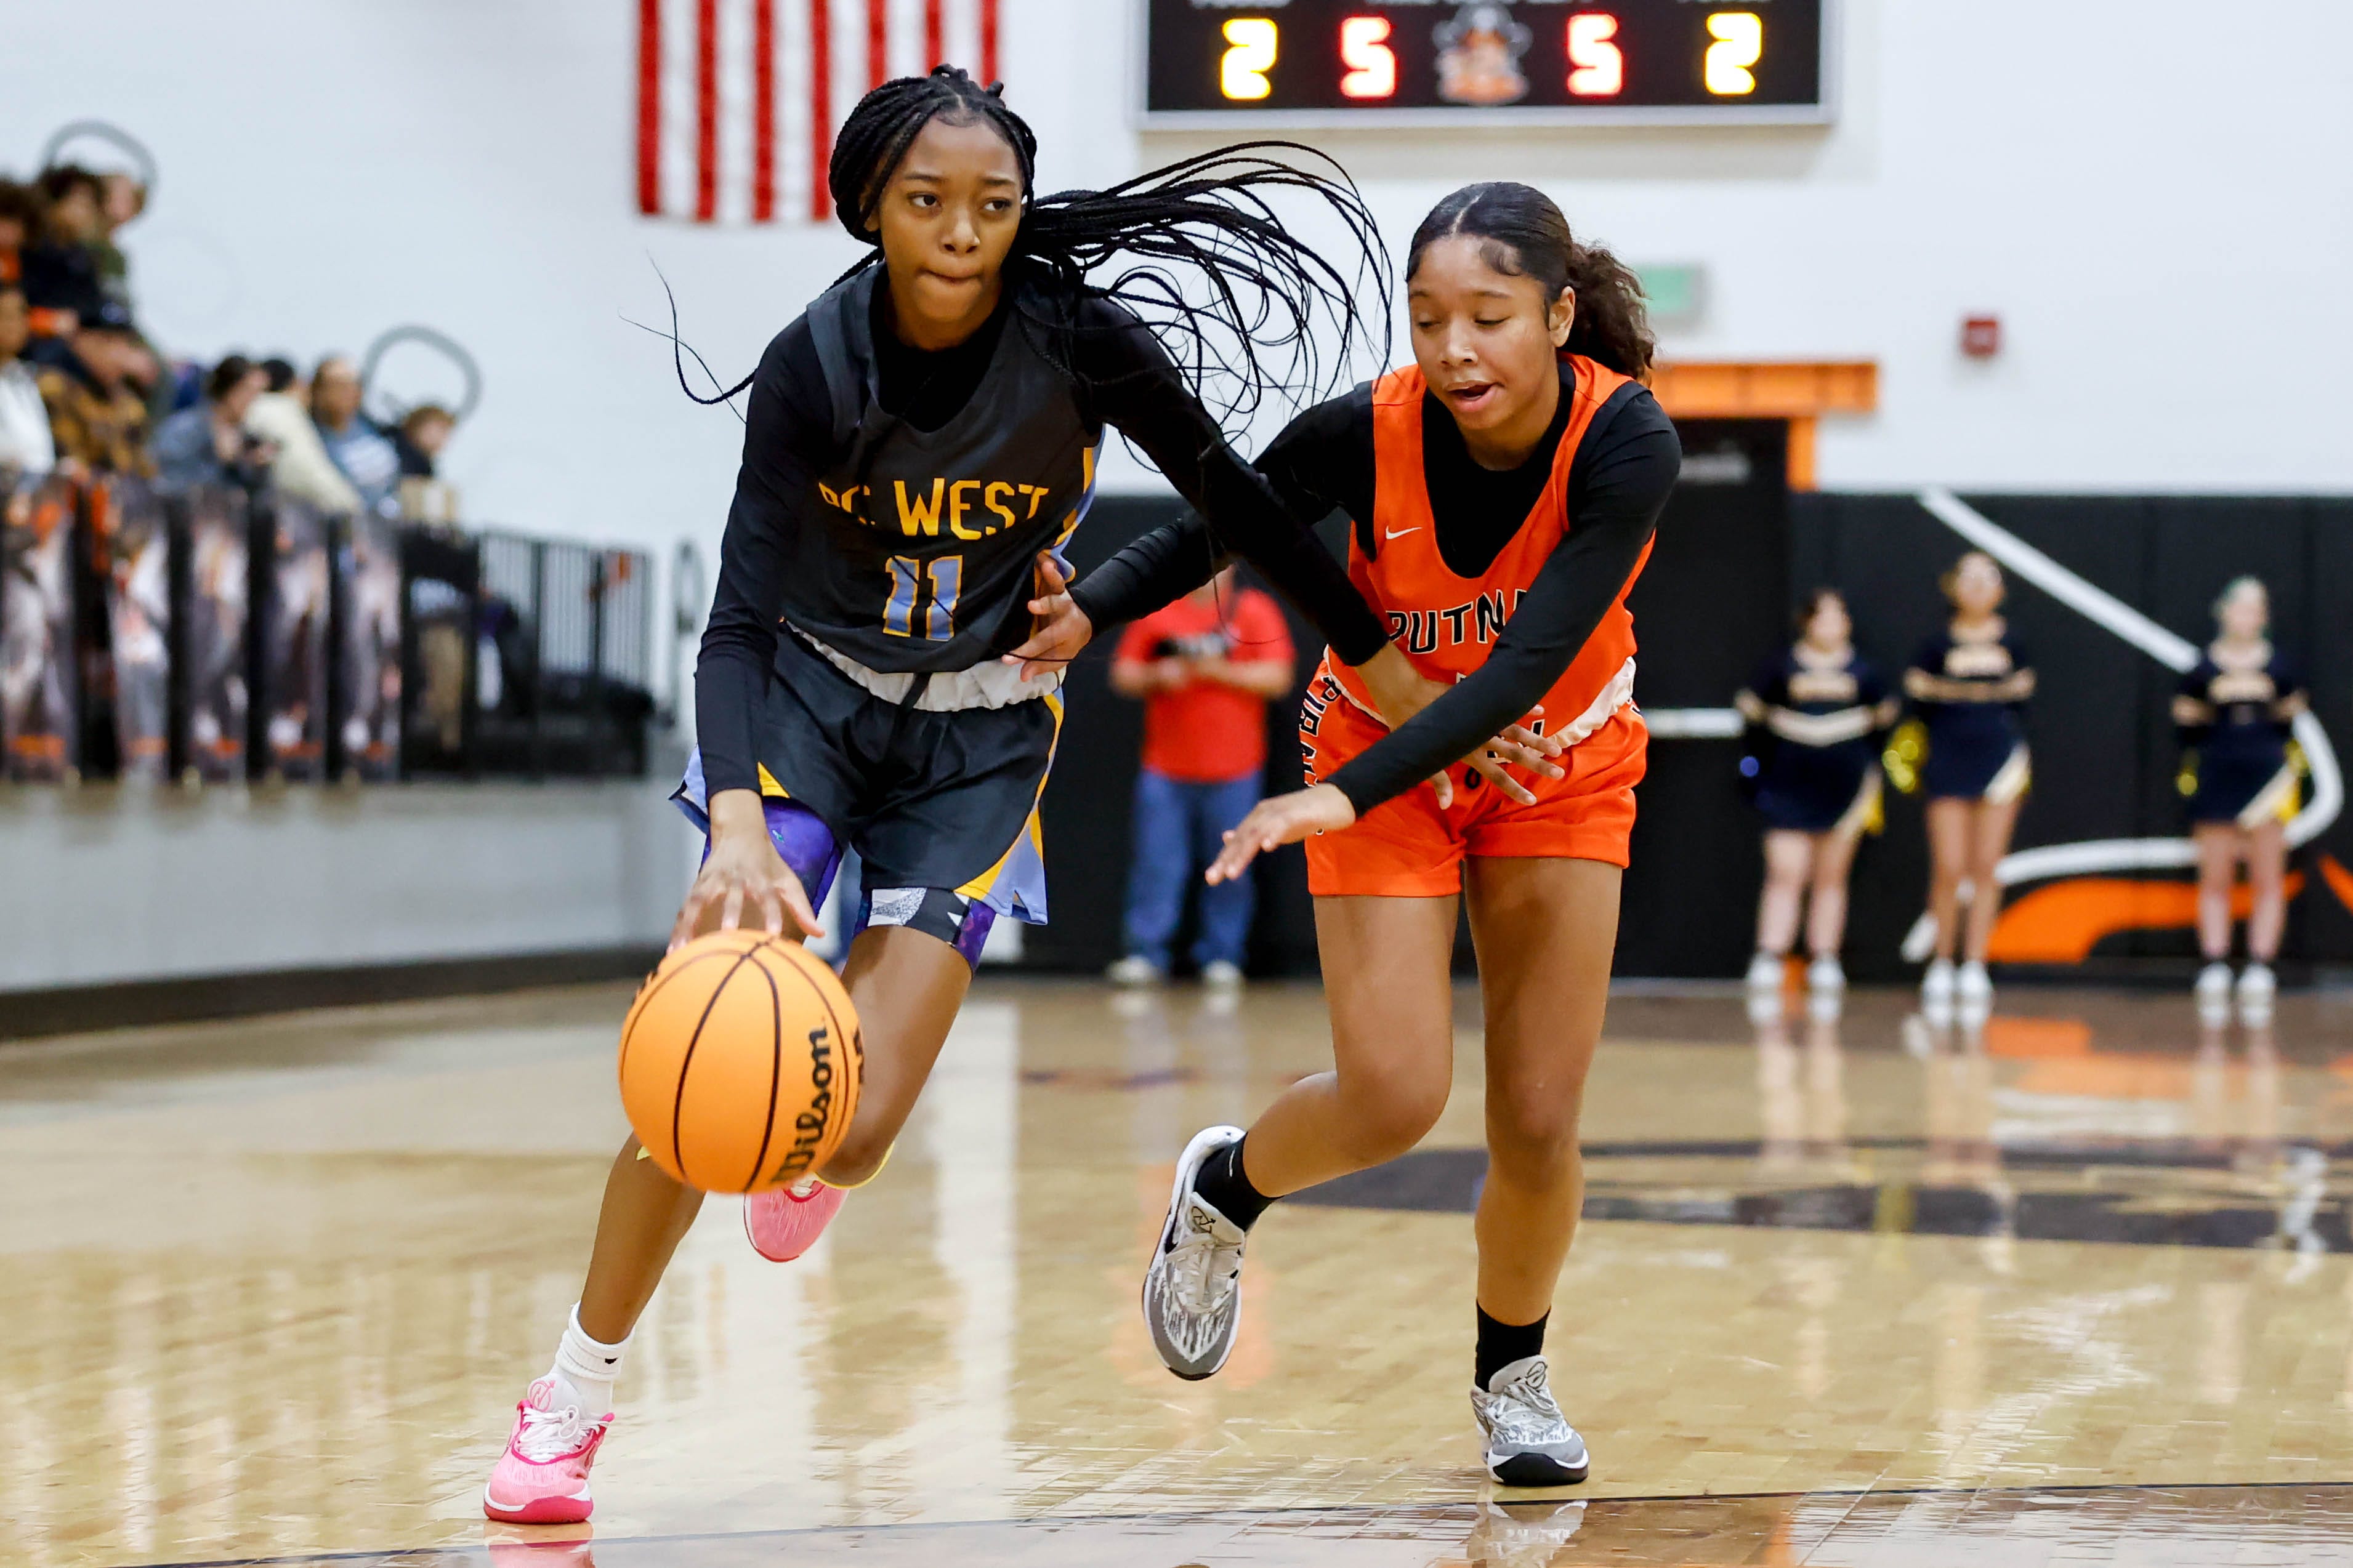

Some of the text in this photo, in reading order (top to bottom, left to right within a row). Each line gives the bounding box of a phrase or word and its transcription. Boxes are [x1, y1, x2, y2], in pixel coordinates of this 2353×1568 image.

[1221, 17, 1278, 100] 2
[1340, 14, 1397, 98] 5
[1567, 12, 1623, 97] 5
[1705, 12, 1763, 96] 2
[894, 477, 1049, 541] WEST
[882, 555, 963, 641] 11
[1385, 588, 1527, 654] PUTN
